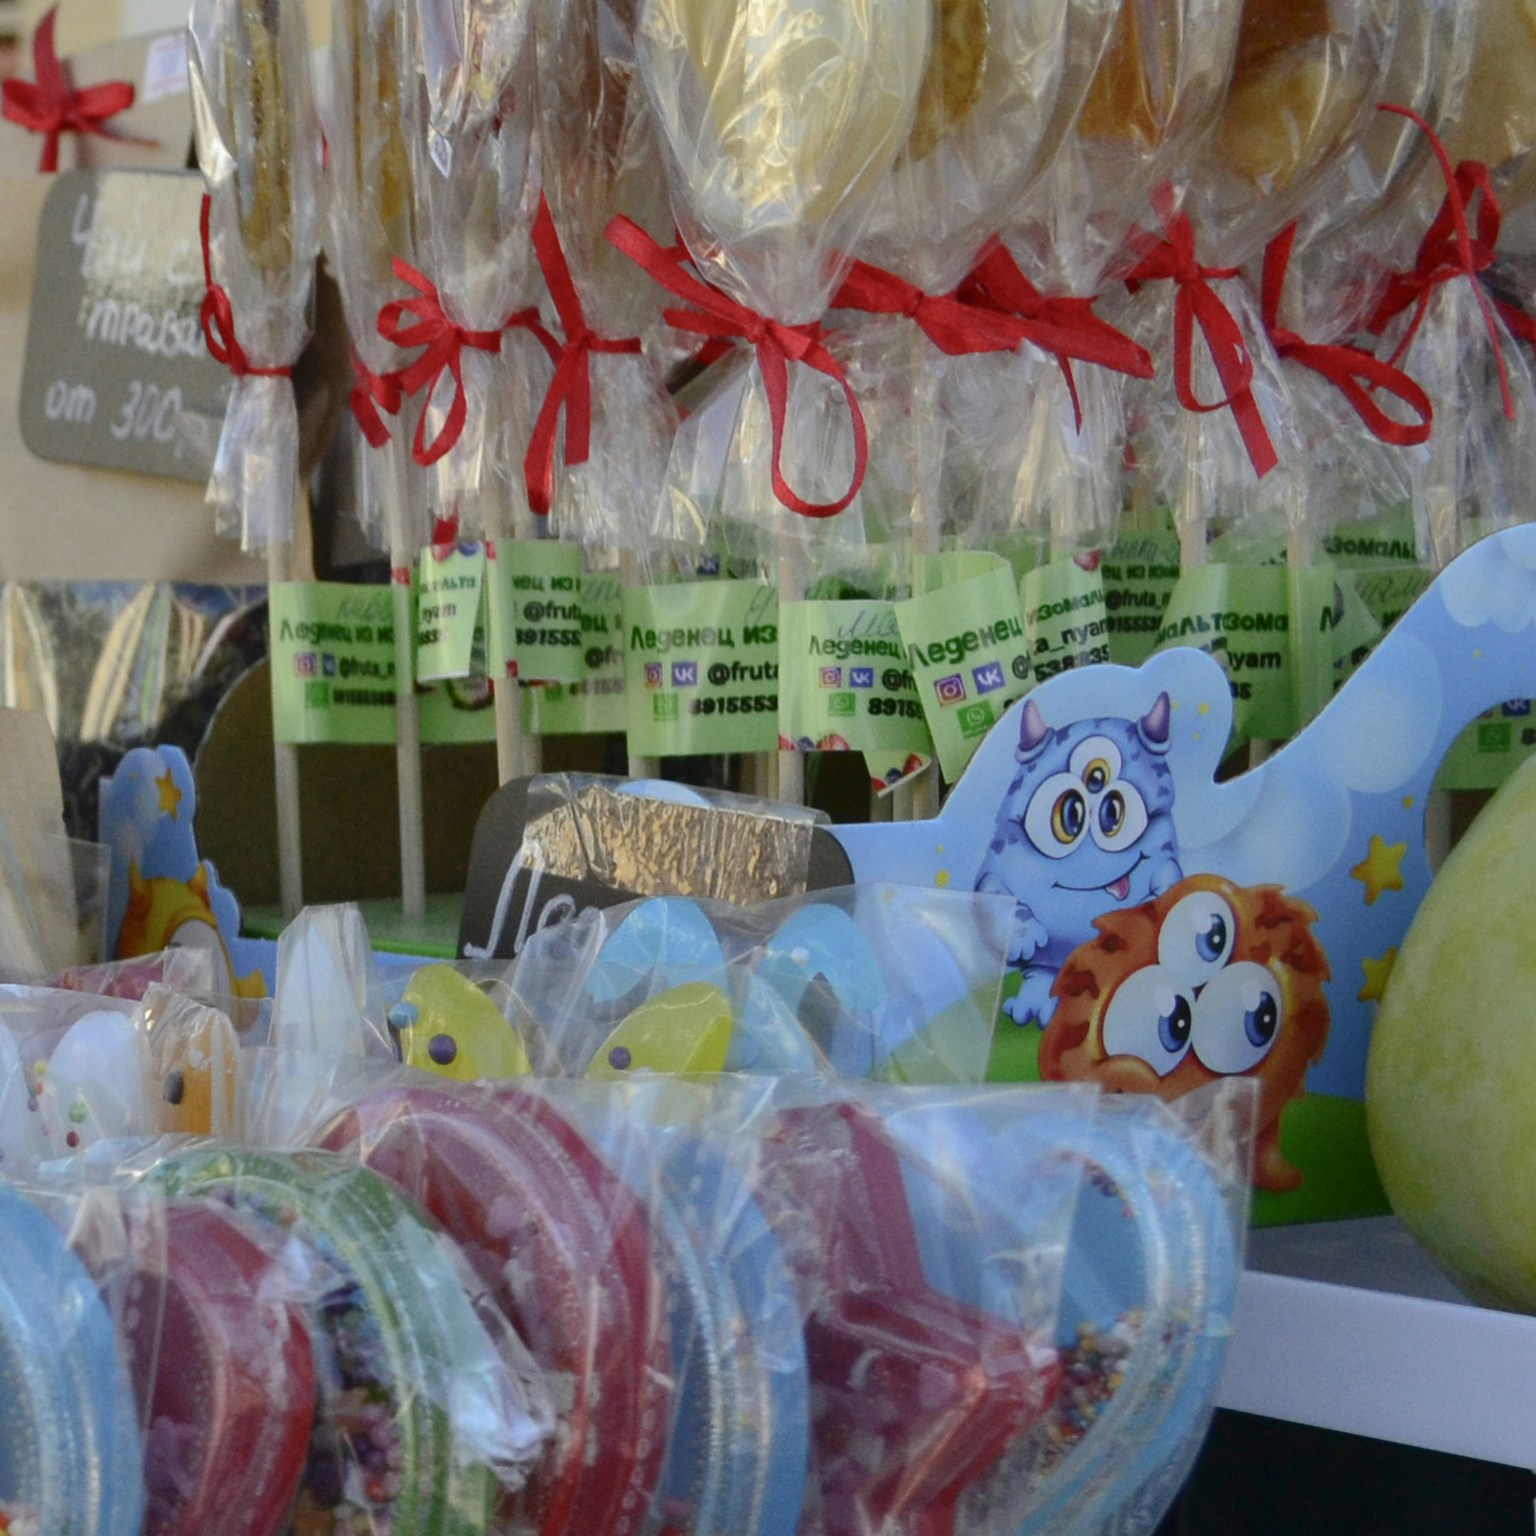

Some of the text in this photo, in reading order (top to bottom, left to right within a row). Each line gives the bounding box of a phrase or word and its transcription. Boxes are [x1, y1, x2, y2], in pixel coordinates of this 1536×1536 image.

[630, 624, 735, 653] Леденец
[809, 635, 900, 660] Леденец
[908, 617, 1023, 669] Леденец
